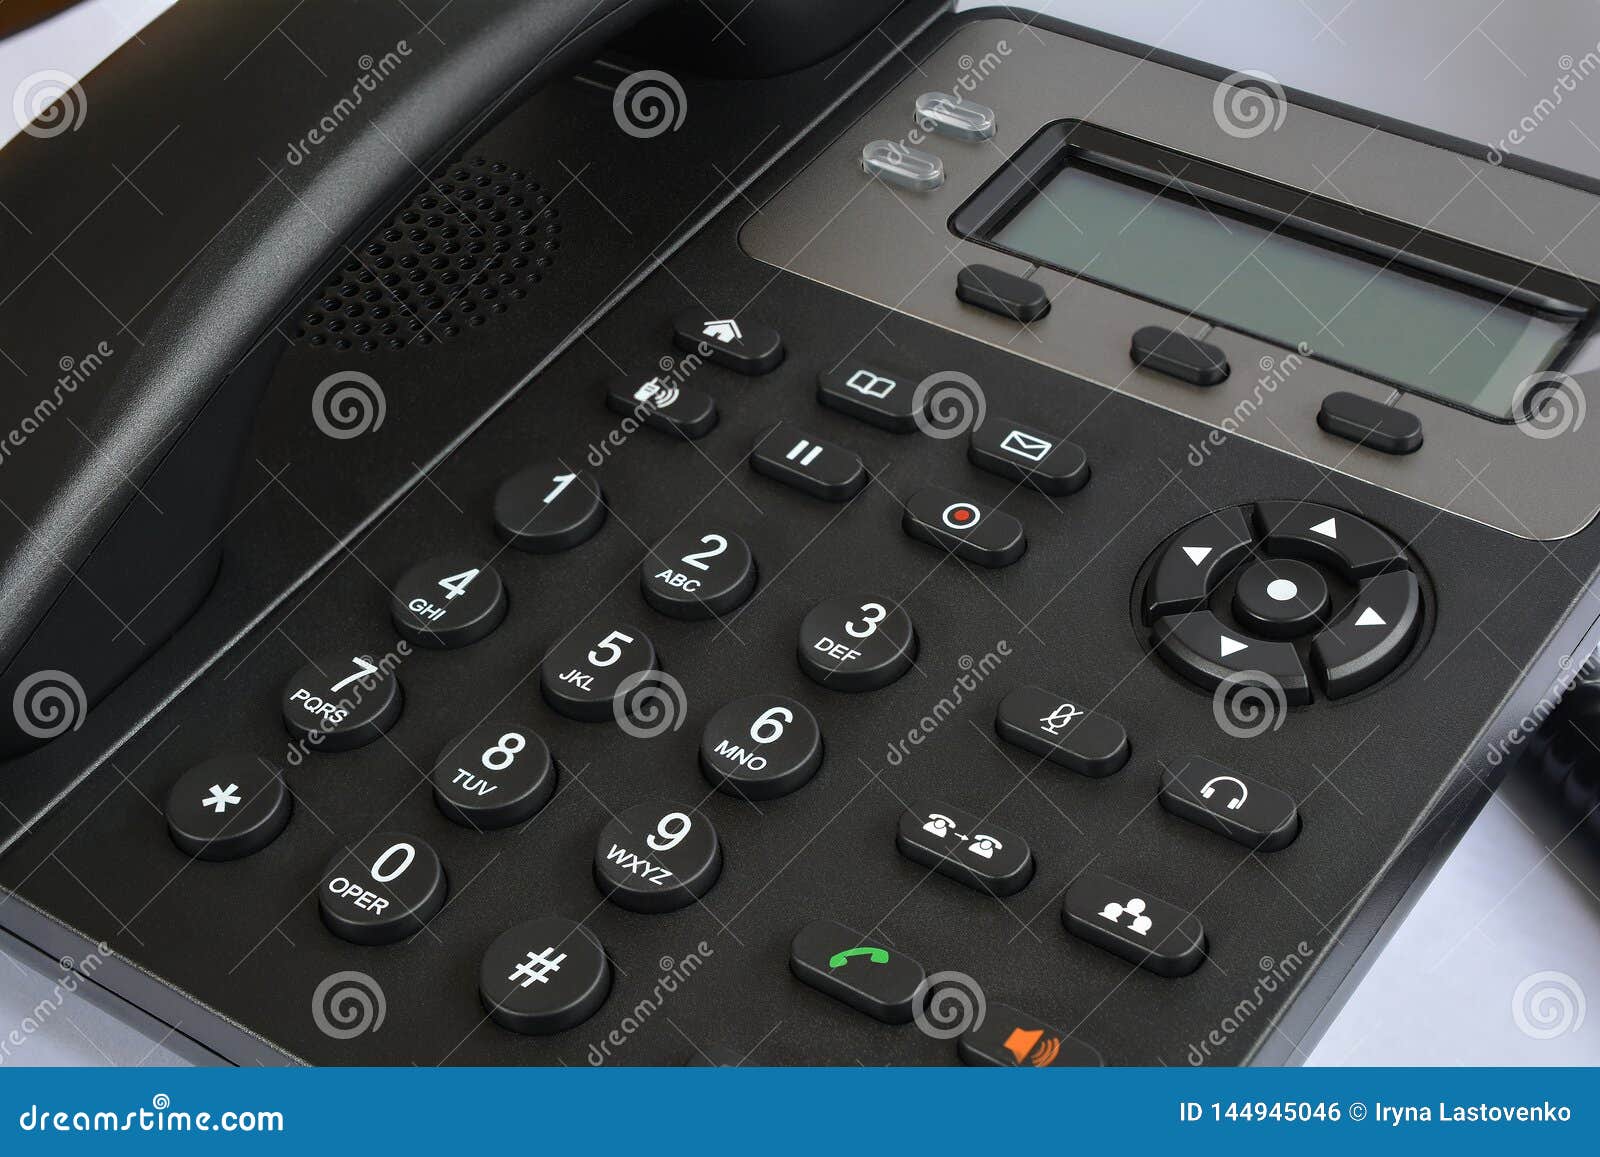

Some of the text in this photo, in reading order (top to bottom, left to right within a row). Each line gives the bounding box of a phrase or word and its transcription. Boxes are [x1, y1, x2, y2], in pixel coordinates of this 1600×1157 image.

[543, 473, 577, 504] 1
[681, 534, 728, 571] 2
[438, 568, 480, 600] 4
[654, 568, 701, 593] ABC
[408, 598, 447, 621] GHI
[844, 602, 887, 638] 3
[587, 630, 634, 667] 5
[813, 636, 862, 662] DEF
[330, 656, 379, 693] 7
[558, 669, 595, 692] JKL
[289, 688, 348, 724] PQRS
[750, 706, 794, 744] 6
[481, 732, 526, 771] 8
[713, 739, 767, 771] MNO
[452, 767, 498, 796] TUV
[646, 812, 692, 852] 9
[370, 842, 416, 883] 0
[606, 843, 674, 886] WXYZ
[328, 877, 390, 916] OPER
[507, 946, 568, 988] #
